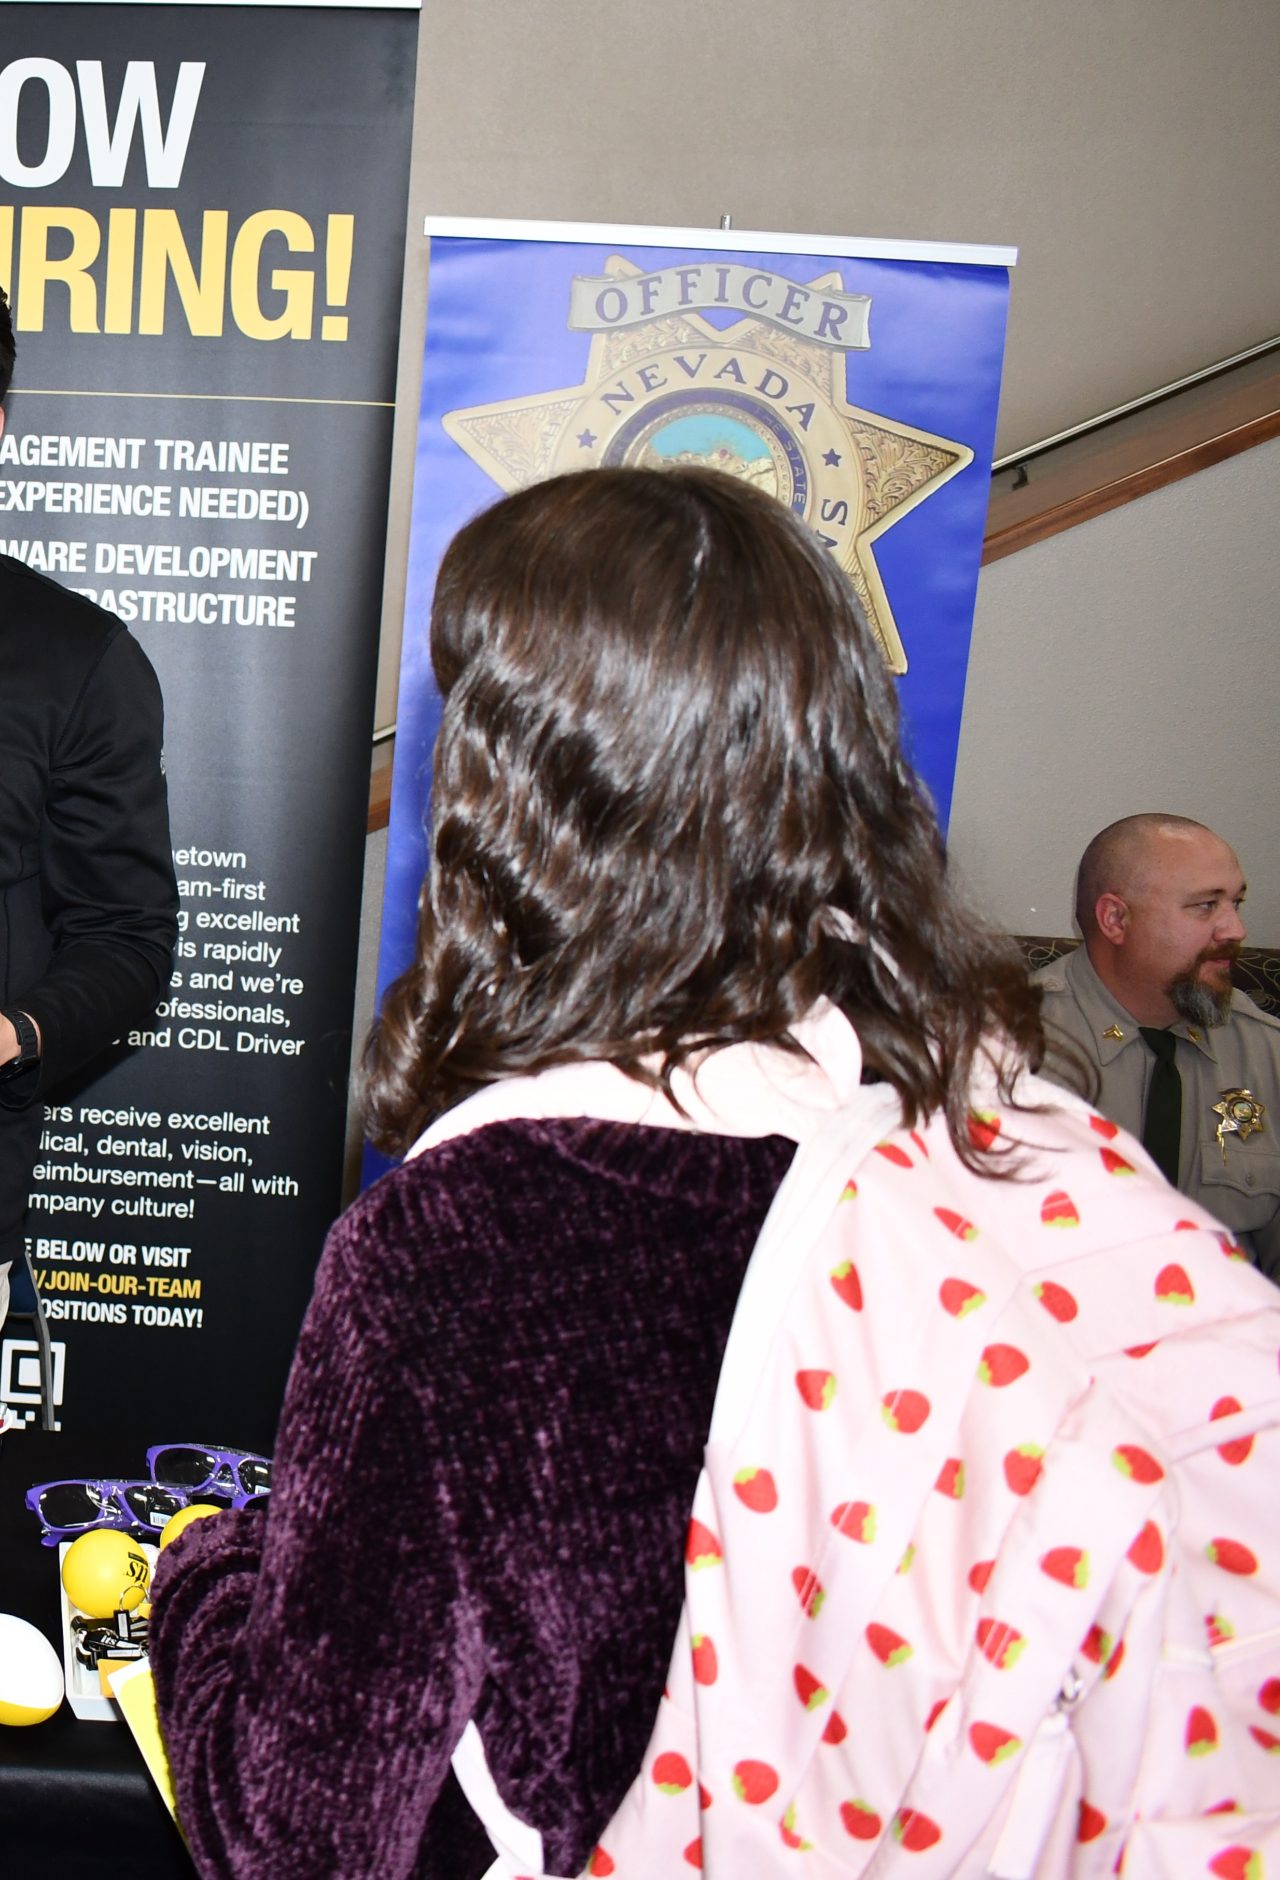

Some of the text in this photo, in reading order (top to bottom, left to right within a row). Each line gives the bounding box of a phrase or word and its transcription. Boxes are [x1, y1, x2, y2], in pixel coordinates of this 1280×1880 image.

[595, 268, 849, 342] OFFICER
[601, 353, 816, 432] NEVADA
[154, 439, 290, 474] TRAINEE
[784, 440, 807, 505] STATE
[178, 487, 310, 529] NEEDED)
[95, 543, 317, 582] DEVELOPMENT
[173, 846, 246, 869] etown
[196, 911, 300, 933] excellent
[177, 937, 282, 968] is rapidly
[189, 970, 234, 991] and
[128, 1028, 306, 1056] and CDL Driver
[80, 1106, 161, 1128] receive
[168, 1112, 271, 1135] excellent
[96, 1135, 174, 1161] dental,
[181, 1139, 254, 1167] vision,
[252, 1175, 300, 1197] with
[111, 1196, 195, 1219] culture!
[36, 1238, 106, 1263] BELOW
[109, 1243, 137, 1264] OR
[142, 1245, 191, 1268] VISIT
[132, 1304, 204, 1329] TODAY!
